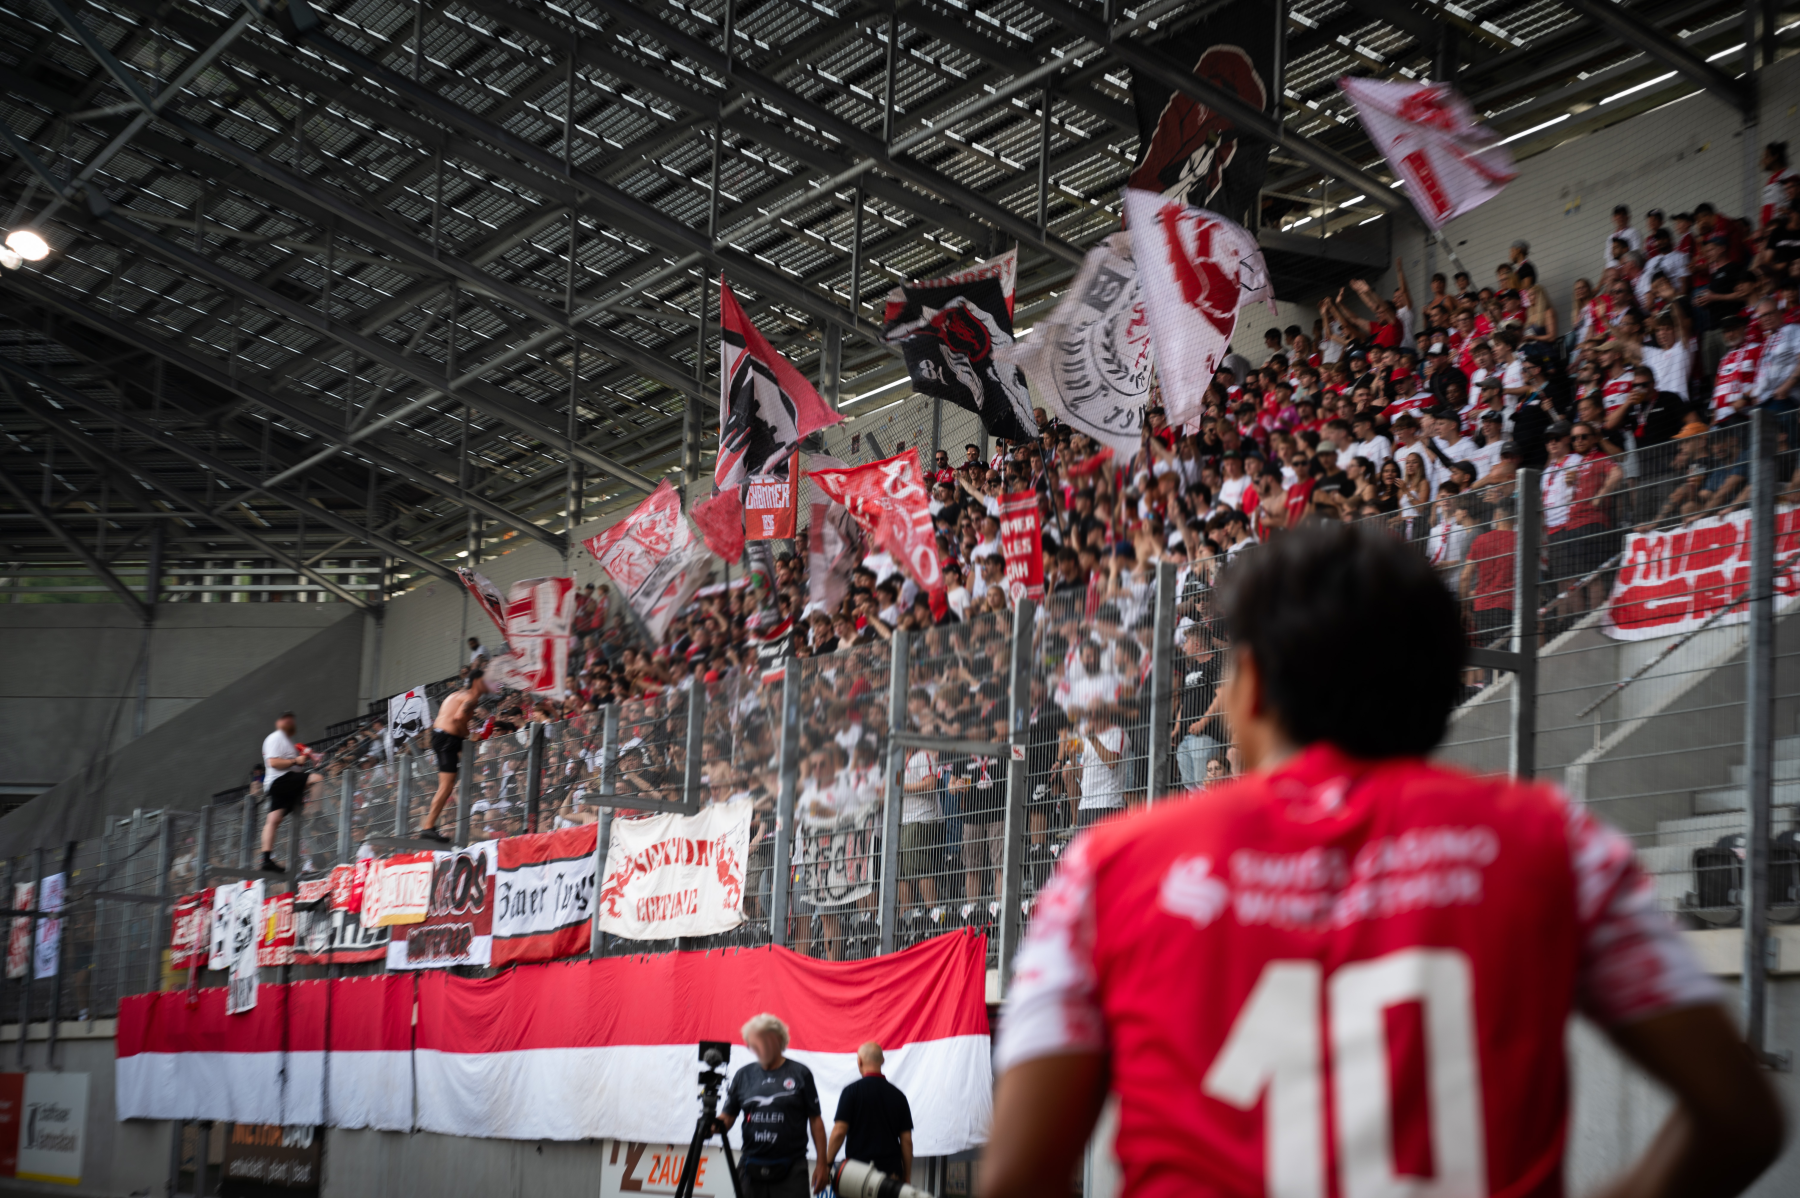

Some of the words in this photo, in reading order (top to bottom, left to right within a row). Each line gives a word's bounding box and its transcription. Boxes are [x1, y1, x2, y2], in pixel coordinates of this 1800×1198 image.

[1203, 946, 1491, 1198] 10
[750, 1111, 785, 1124] KELLER
[647, 1144, 709, 1188] ZÄUE
